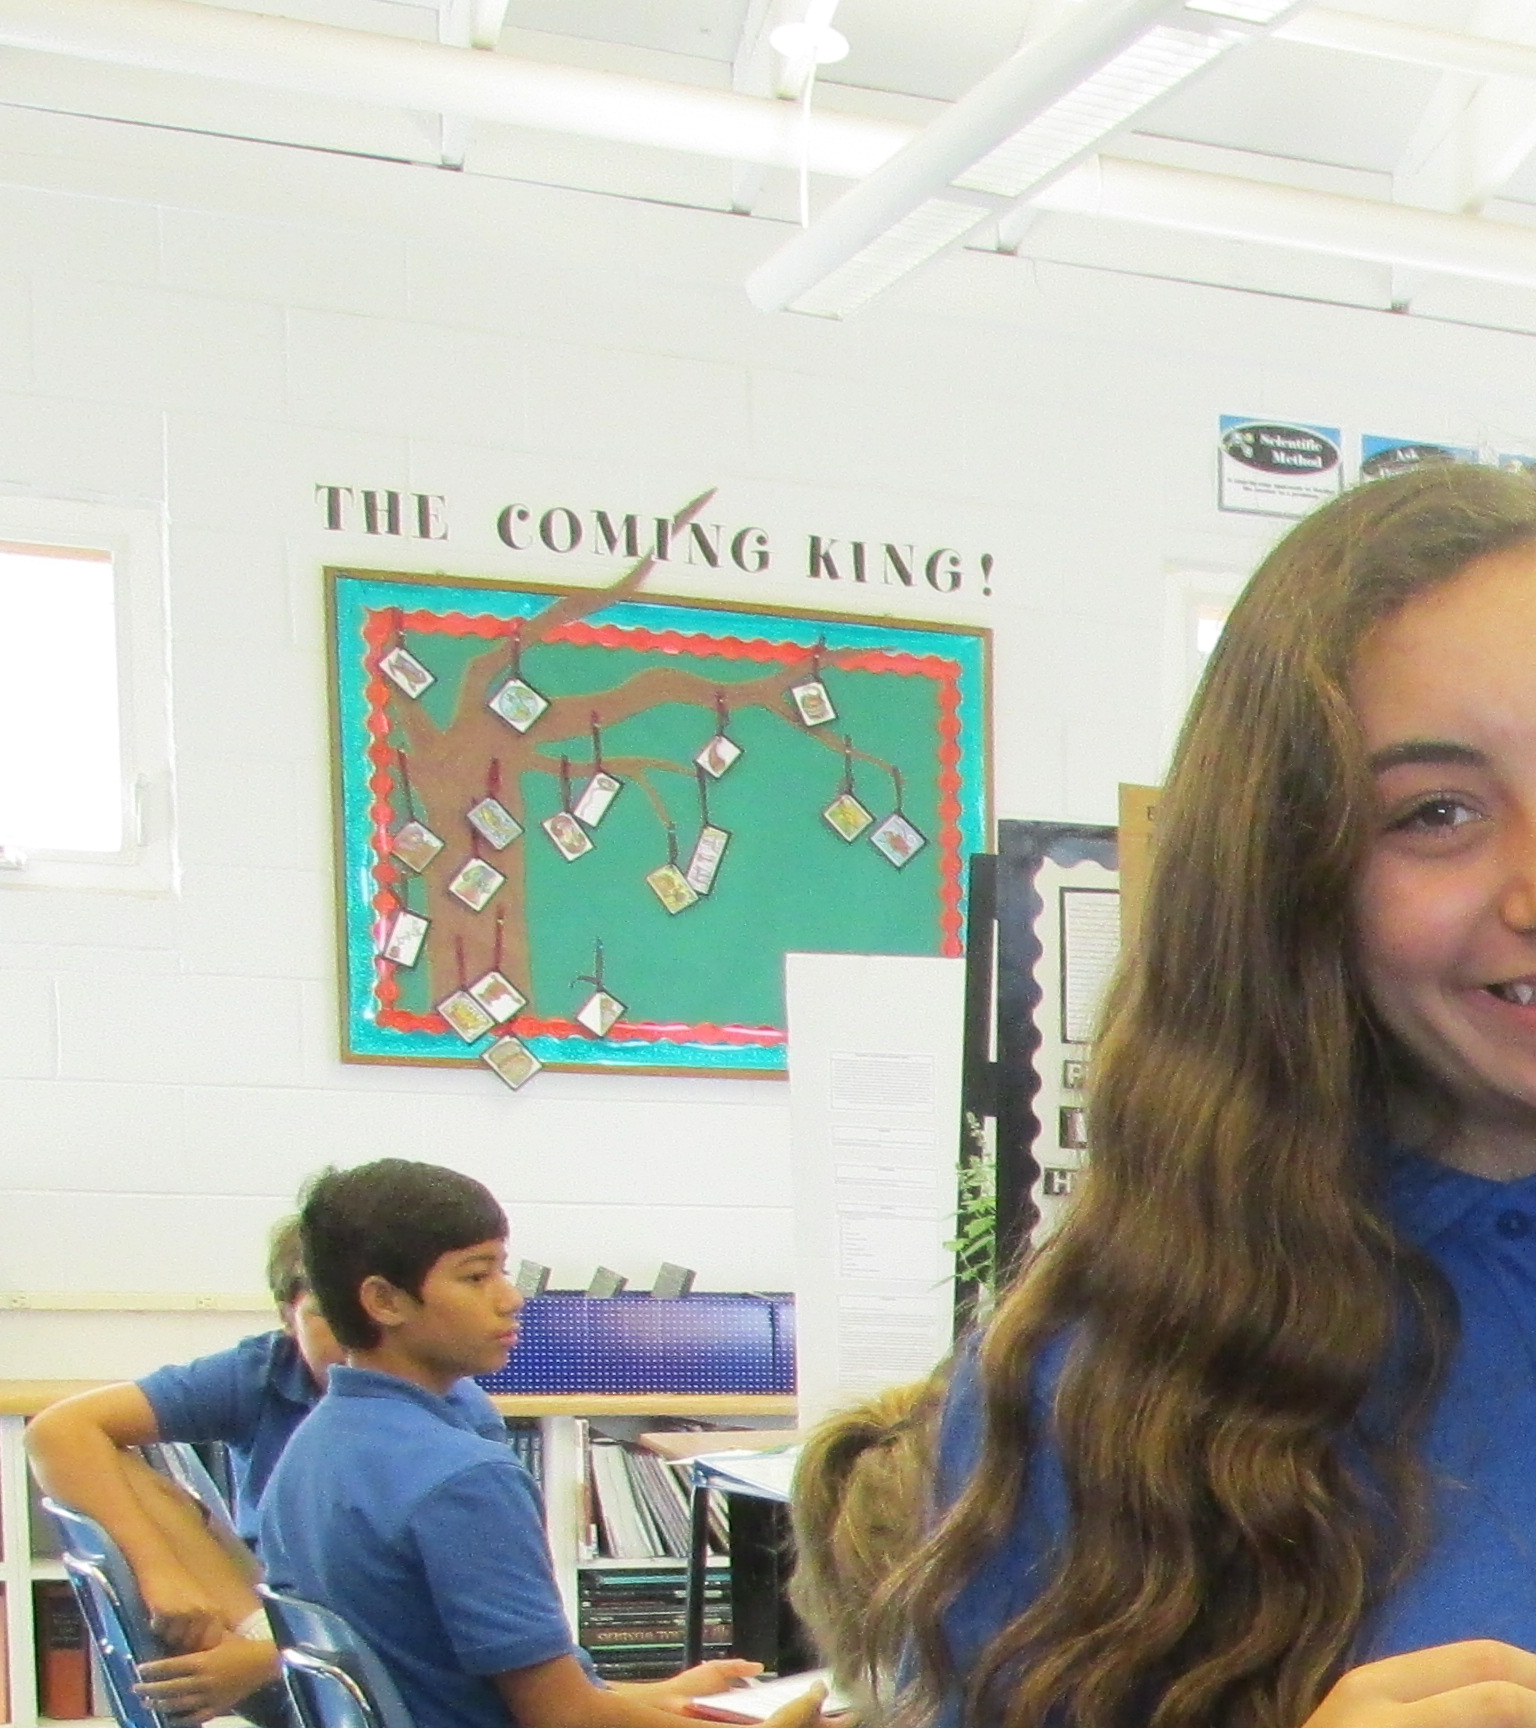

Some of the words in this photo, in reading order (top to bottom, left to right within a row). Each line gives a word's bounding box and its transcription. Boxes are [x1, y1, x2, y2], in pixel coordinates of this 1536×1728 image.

[1258, 432, 1323, 452] Scientific
[1271, 449, 1323, 468] Method
[316, 483, 449, 541] THE
[497, 502, 771, 570] COMING
[806, 534, 995, 597] KING!
